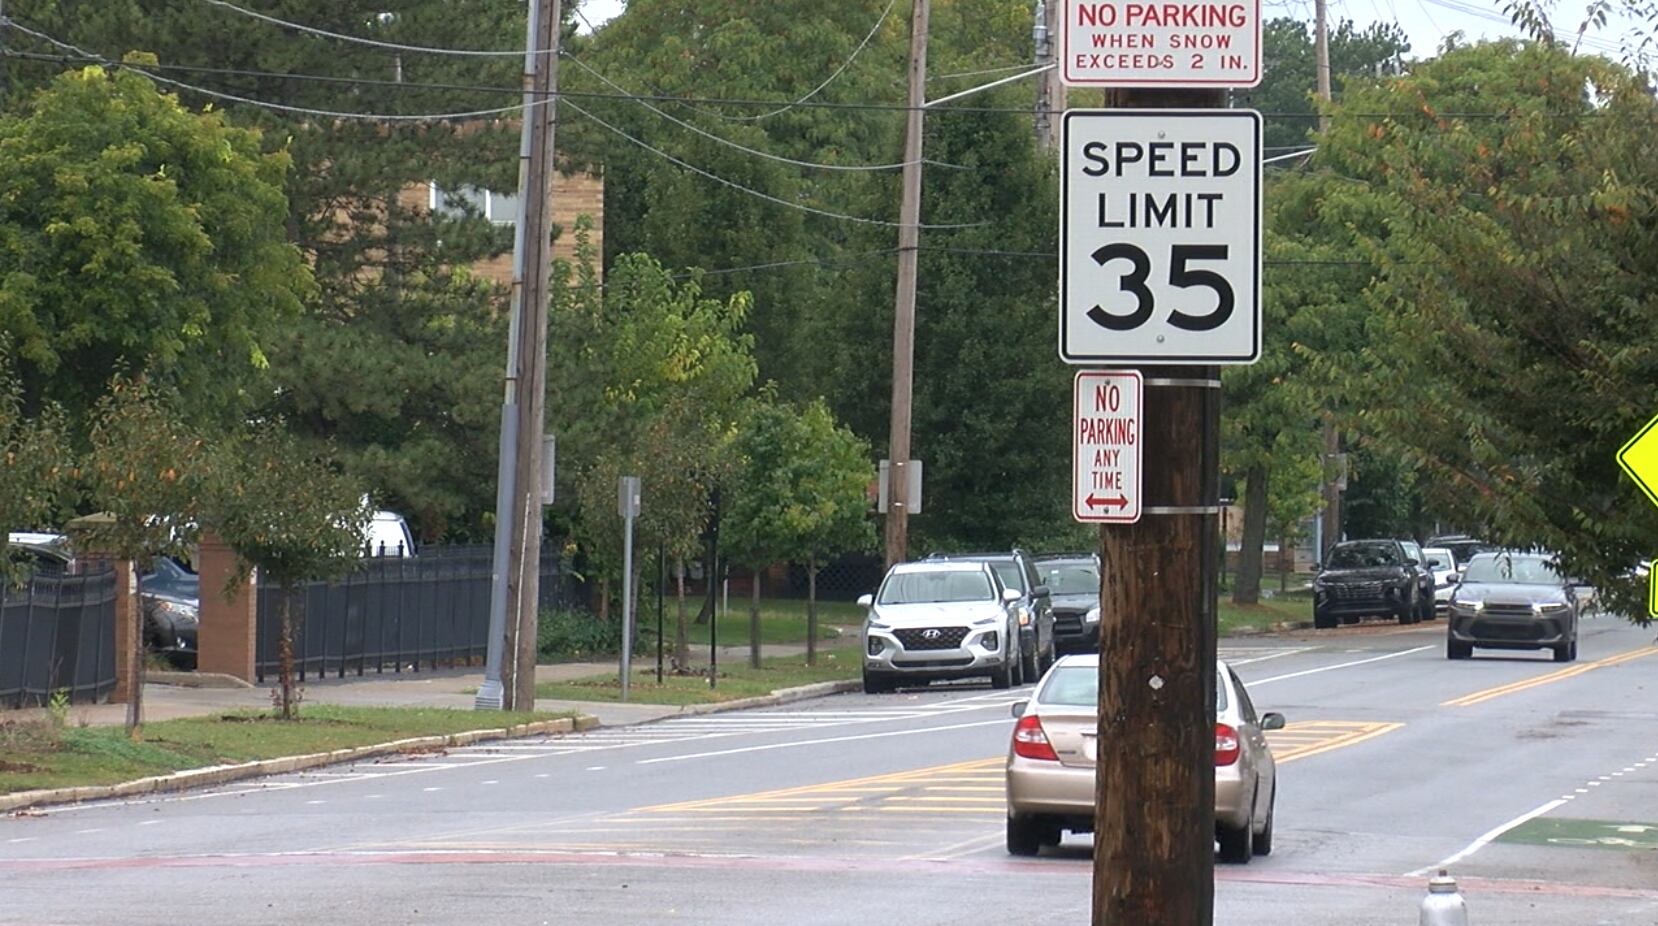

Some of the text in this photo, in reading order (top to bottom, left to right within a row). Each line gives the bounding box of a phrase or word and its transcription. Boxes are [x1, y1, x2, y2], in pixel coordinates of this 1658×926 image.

[1078, 4, 1246, 28] NO PARKING
[1092, 34, 1231, 49] WHEN SNOW
[1076, 53, 1248, 70] EXCEEDS 2 IN.
[1082, 141, 1241, 177] SPEED
[1098, 193, 1223, 228] LIMIT
[1086, 242, 1235, 332] 35
[1095, 385, 1120, 412] NO
[1080, 418, 1135, 446] PARKING
[1094, 449, 1121, 467] ANY
[1092, 471, 1122, 490] TIME
